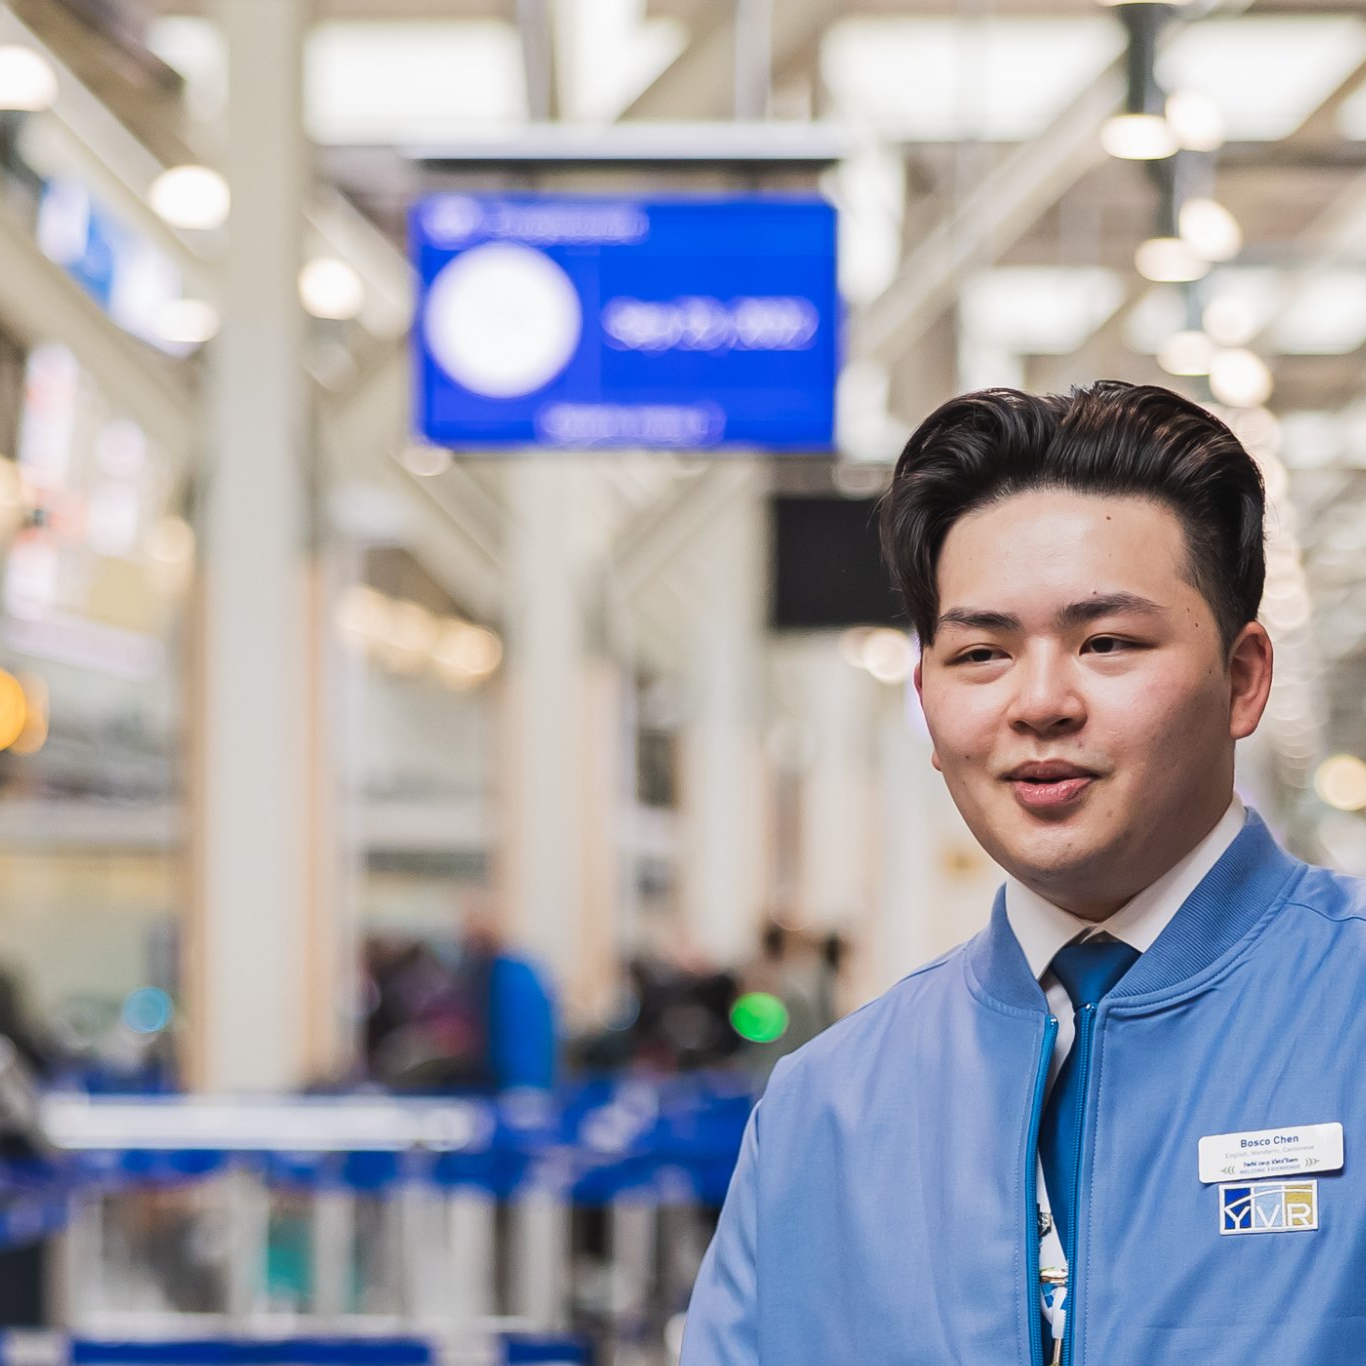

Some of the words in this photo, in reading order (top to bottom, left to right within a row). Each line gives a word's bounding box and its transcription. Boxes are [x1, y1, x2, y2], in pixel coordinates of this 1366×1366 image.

[1240, 1138, 1270, 1148] Bosco
[1273, 1135, 1300, 1145] Chen
[1223, 1192, 1313, 1230] YVR
